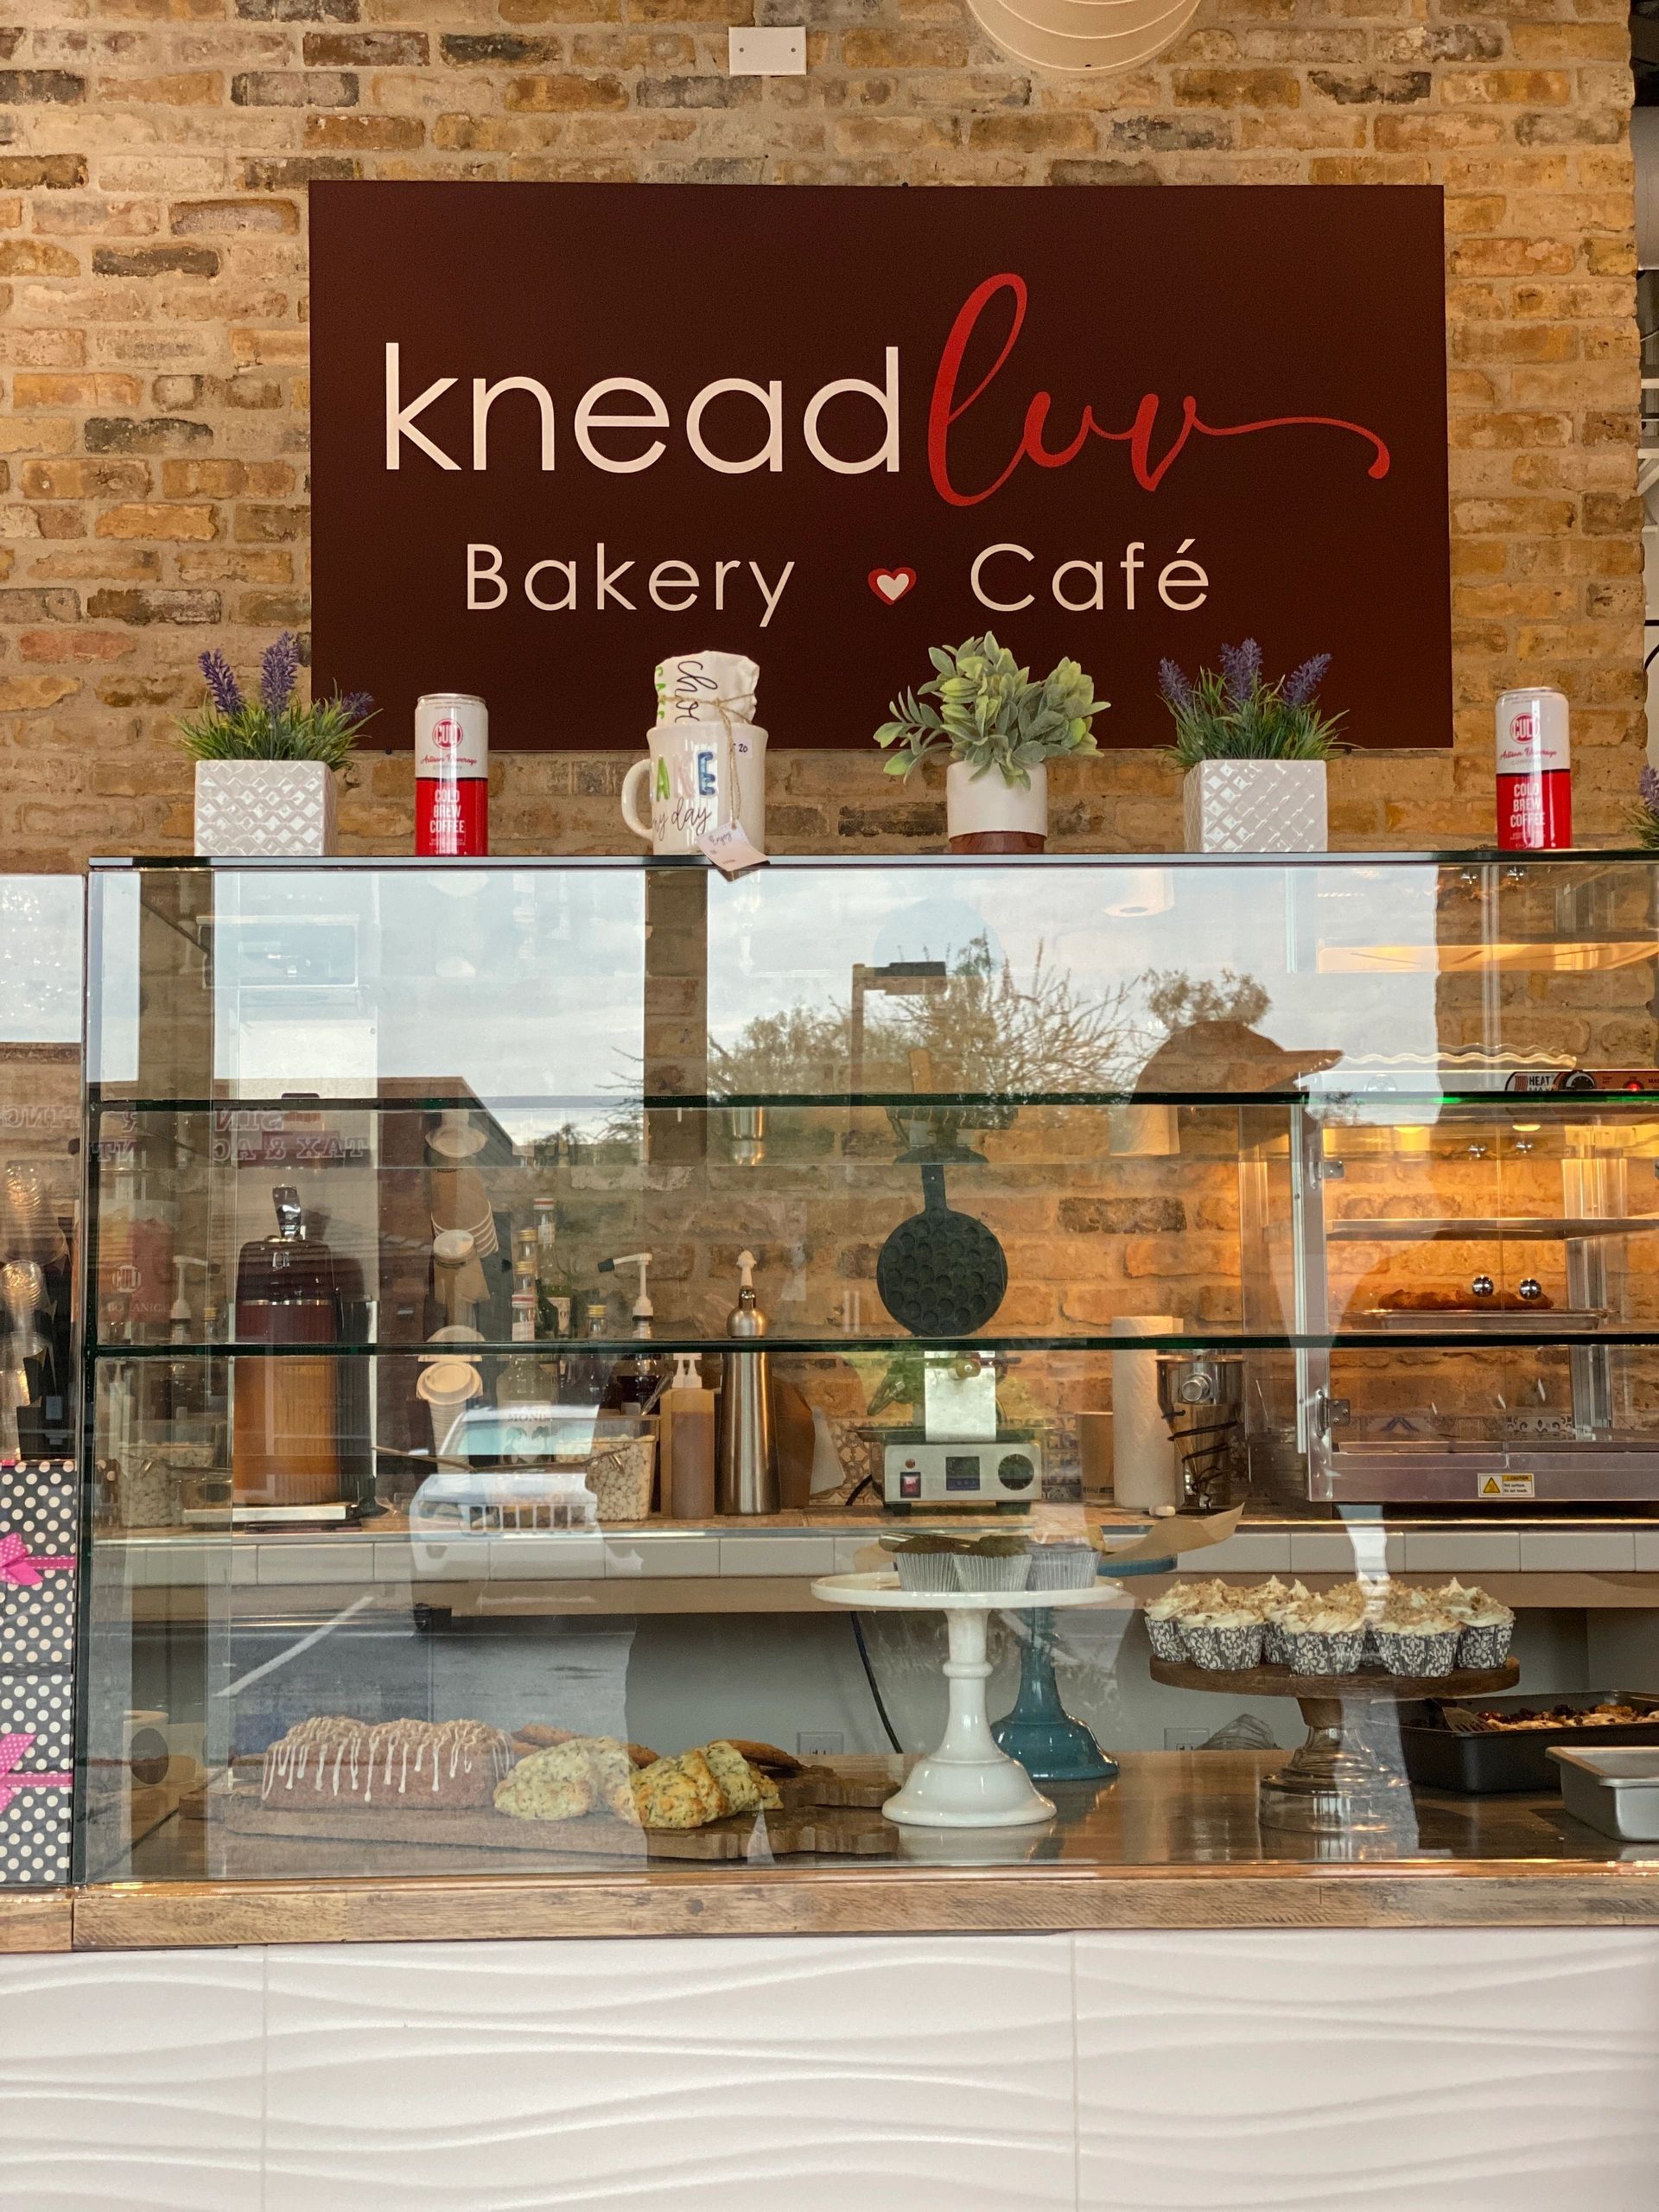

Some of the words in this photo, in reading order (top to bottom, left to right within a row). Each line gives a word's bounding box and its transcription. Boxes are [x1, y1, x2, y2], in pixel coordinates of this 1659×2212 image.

[386, 342, 899, 474] knead
[929, 274, 1389, 505] luv
[467, 543, 795, 627] Bakery
[971, 538, 1209, 612] Café
[446, 753, 478, 766] Bverage
[1523, 746, 1557, 760] Beerage
[650, 750, 716, 803] AKE
[435, 789, 460, 803] COLD
[1514, 783, 1540, 798] COLD
[433, 804, 462, 817] BREW
[1513, 798, 1541, 812] BREW
[671, 796, 712, 836] day
[1510, 812, 1546, 828] COFFEE
[429, 820, 466, 833] COFFEE
[1529, 1076, 1551, 1086] HEAT
